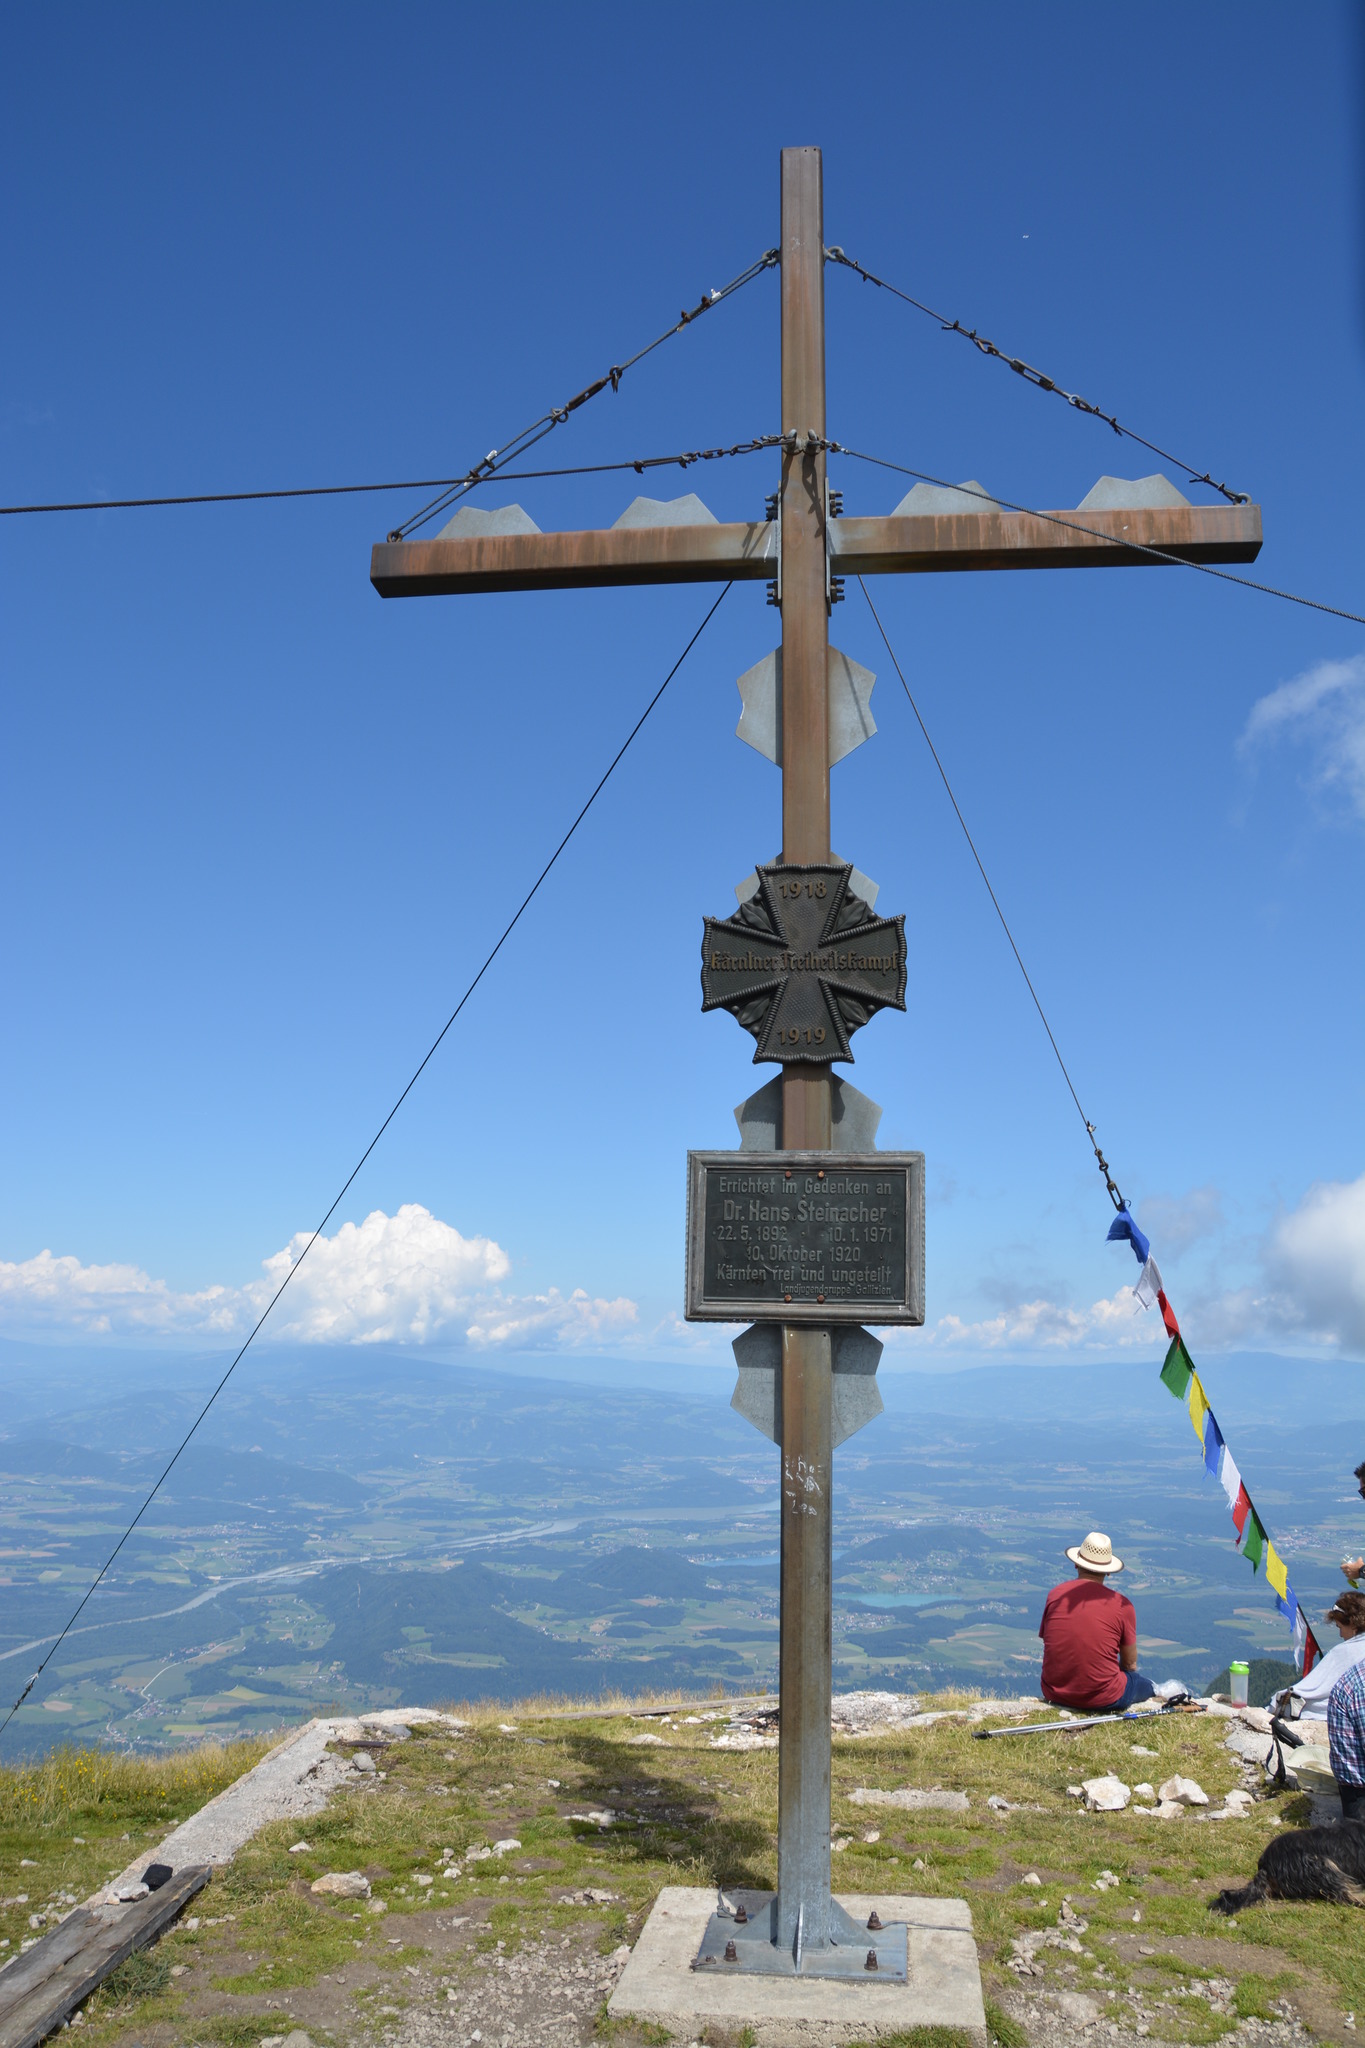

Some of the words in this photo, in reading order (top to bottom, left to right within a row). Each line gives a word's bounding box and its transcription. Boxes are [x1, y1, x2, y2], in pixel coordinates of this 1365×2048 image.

[779, 880, 828, 899] 1918
[777, 1026, 826, 1045] 1919
[719, 1176, 775, 1193] Errichtet
[782, 1178, 797, 1194] im
[804, 1178, 869, 1194] Gedenken
[876, 1182, 892, 1195] an
[723, 1199, 745, 1222] Dr.
[750, 1199, 791, 1222] Hans
[797, 1200, 887, 1223] Steinacher
[769, 1244, 822, 1262] Oktober
[830, 1247, 861, 1262] 1920
[716, 1263, 767, 1281] Kärnten
[772, 1264, 795, 1281] frei
[801, 1266, 825, 1282] und
[831, 1267, 892, 1286] ungeteilt
[780, 1283, 851, 1297] Landjugendgruppe
[856, 1284, 892, 1295] Gallizien
